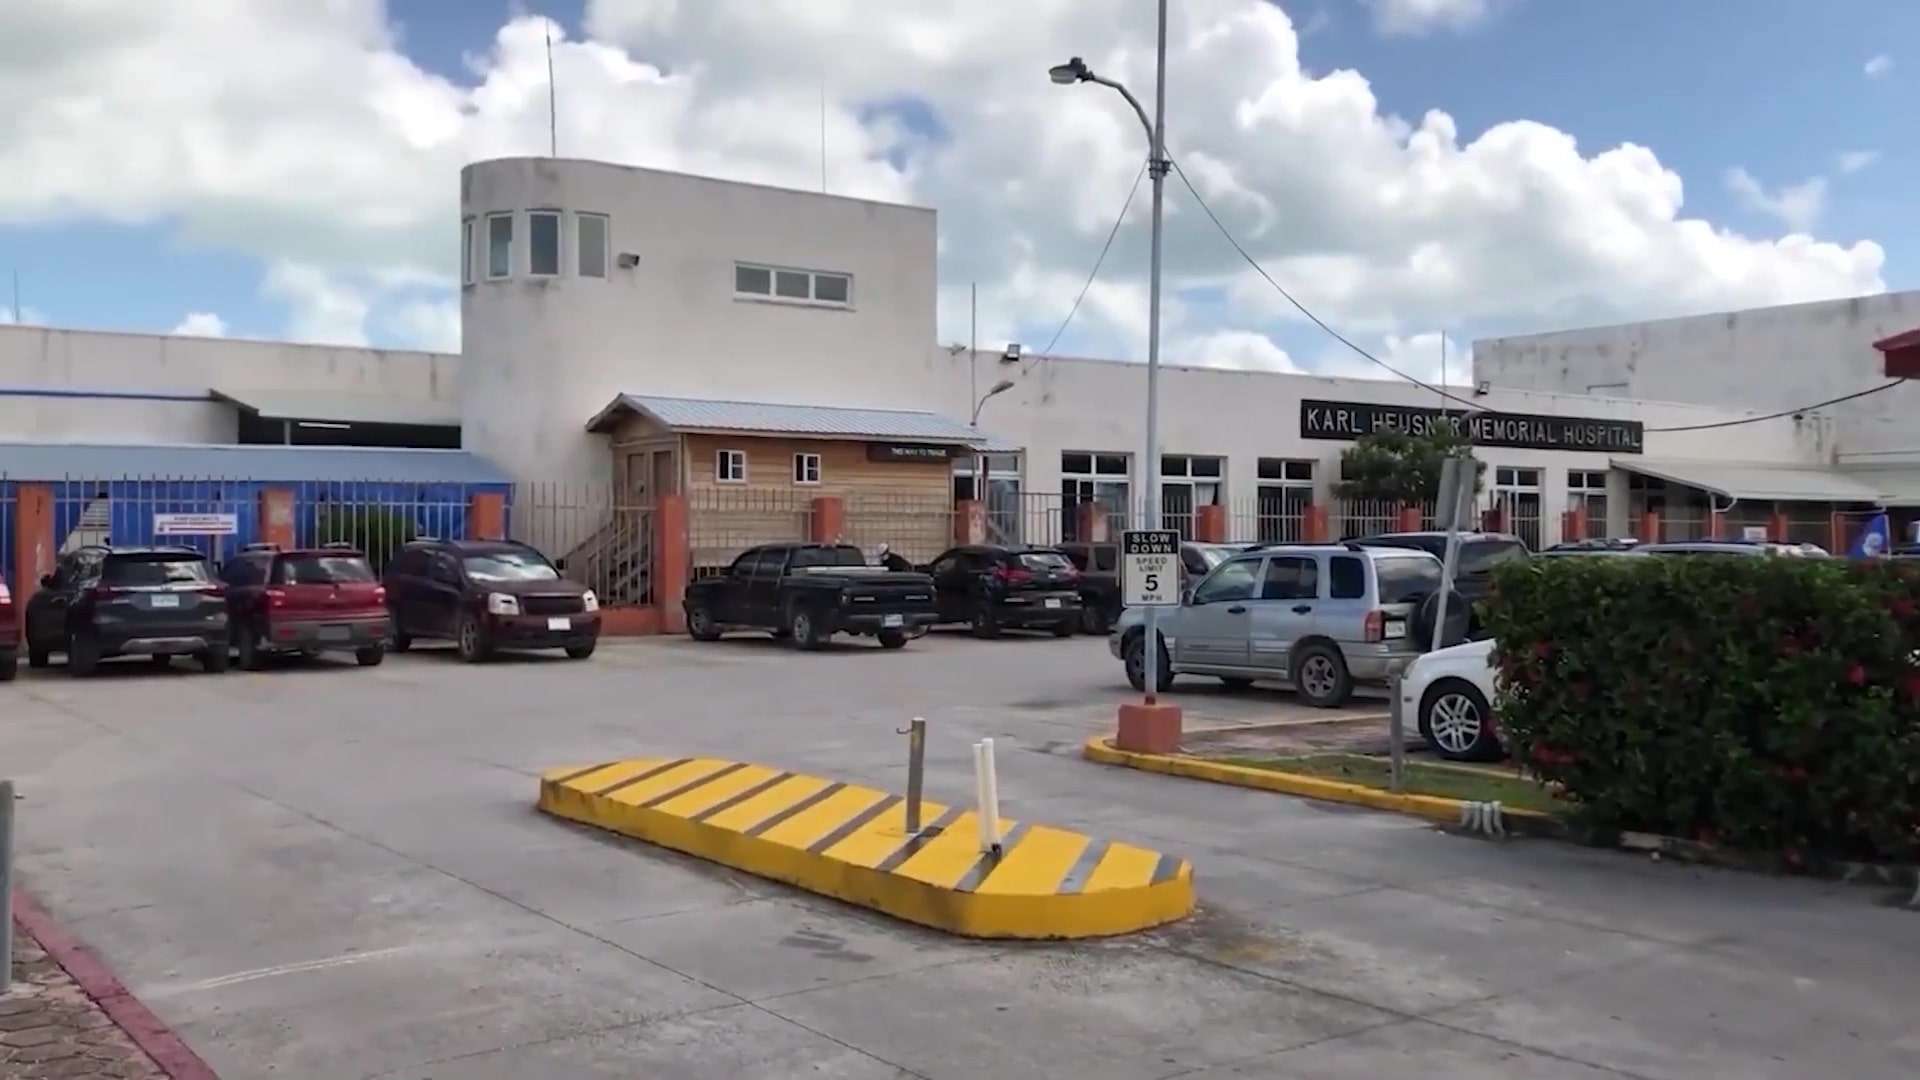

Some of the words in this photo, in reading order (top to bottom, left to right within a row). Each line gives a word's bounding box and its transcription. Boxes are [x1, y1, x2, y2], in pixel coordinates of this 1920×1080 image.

[1307, 408, 1363, 433] KARL
[1371, 412, 1461, 438] HEUSNR
[1469, 418, 1558, 443] MEMORIAL
[1563, 425, 1641, 447] HOSPITAL
[1131, 533, 1170, 543] SLOW
[1130, 544, 1172, 553] DOWN
[1136, 556, 1168, 565] SPEED
[1145, 574, 1158, 592] 5
